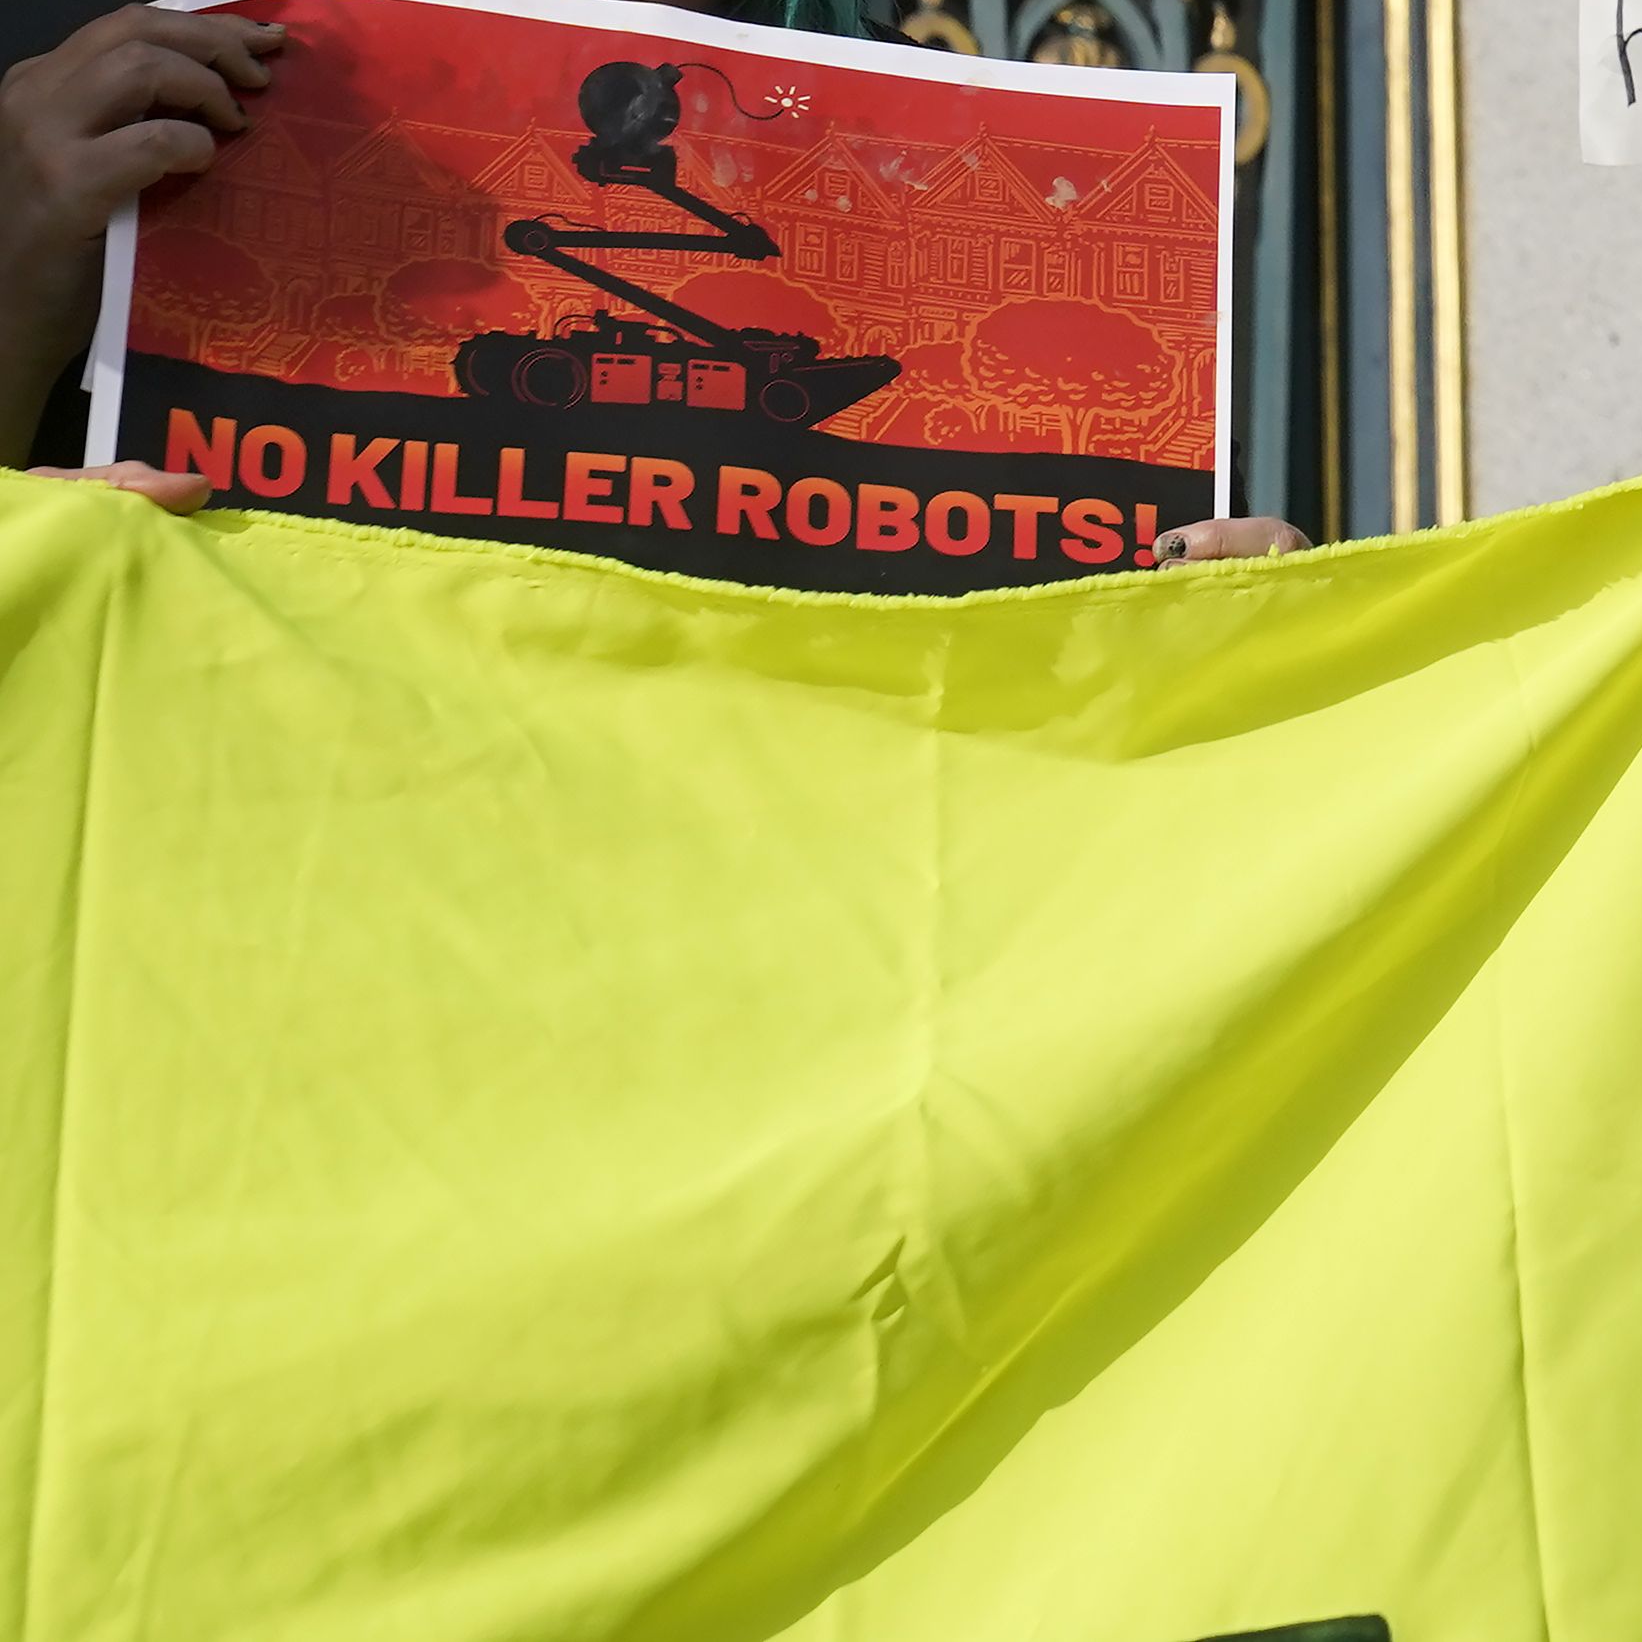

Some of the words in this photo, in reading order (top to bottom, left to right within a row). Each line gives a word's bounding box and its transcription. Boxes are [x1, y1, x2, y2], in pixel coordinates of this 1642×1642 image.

[163, 408, 308, 498] NO
[326, 432, 696, 530] KILLER
[716, 464, 1158, 568] ROBOTS!
